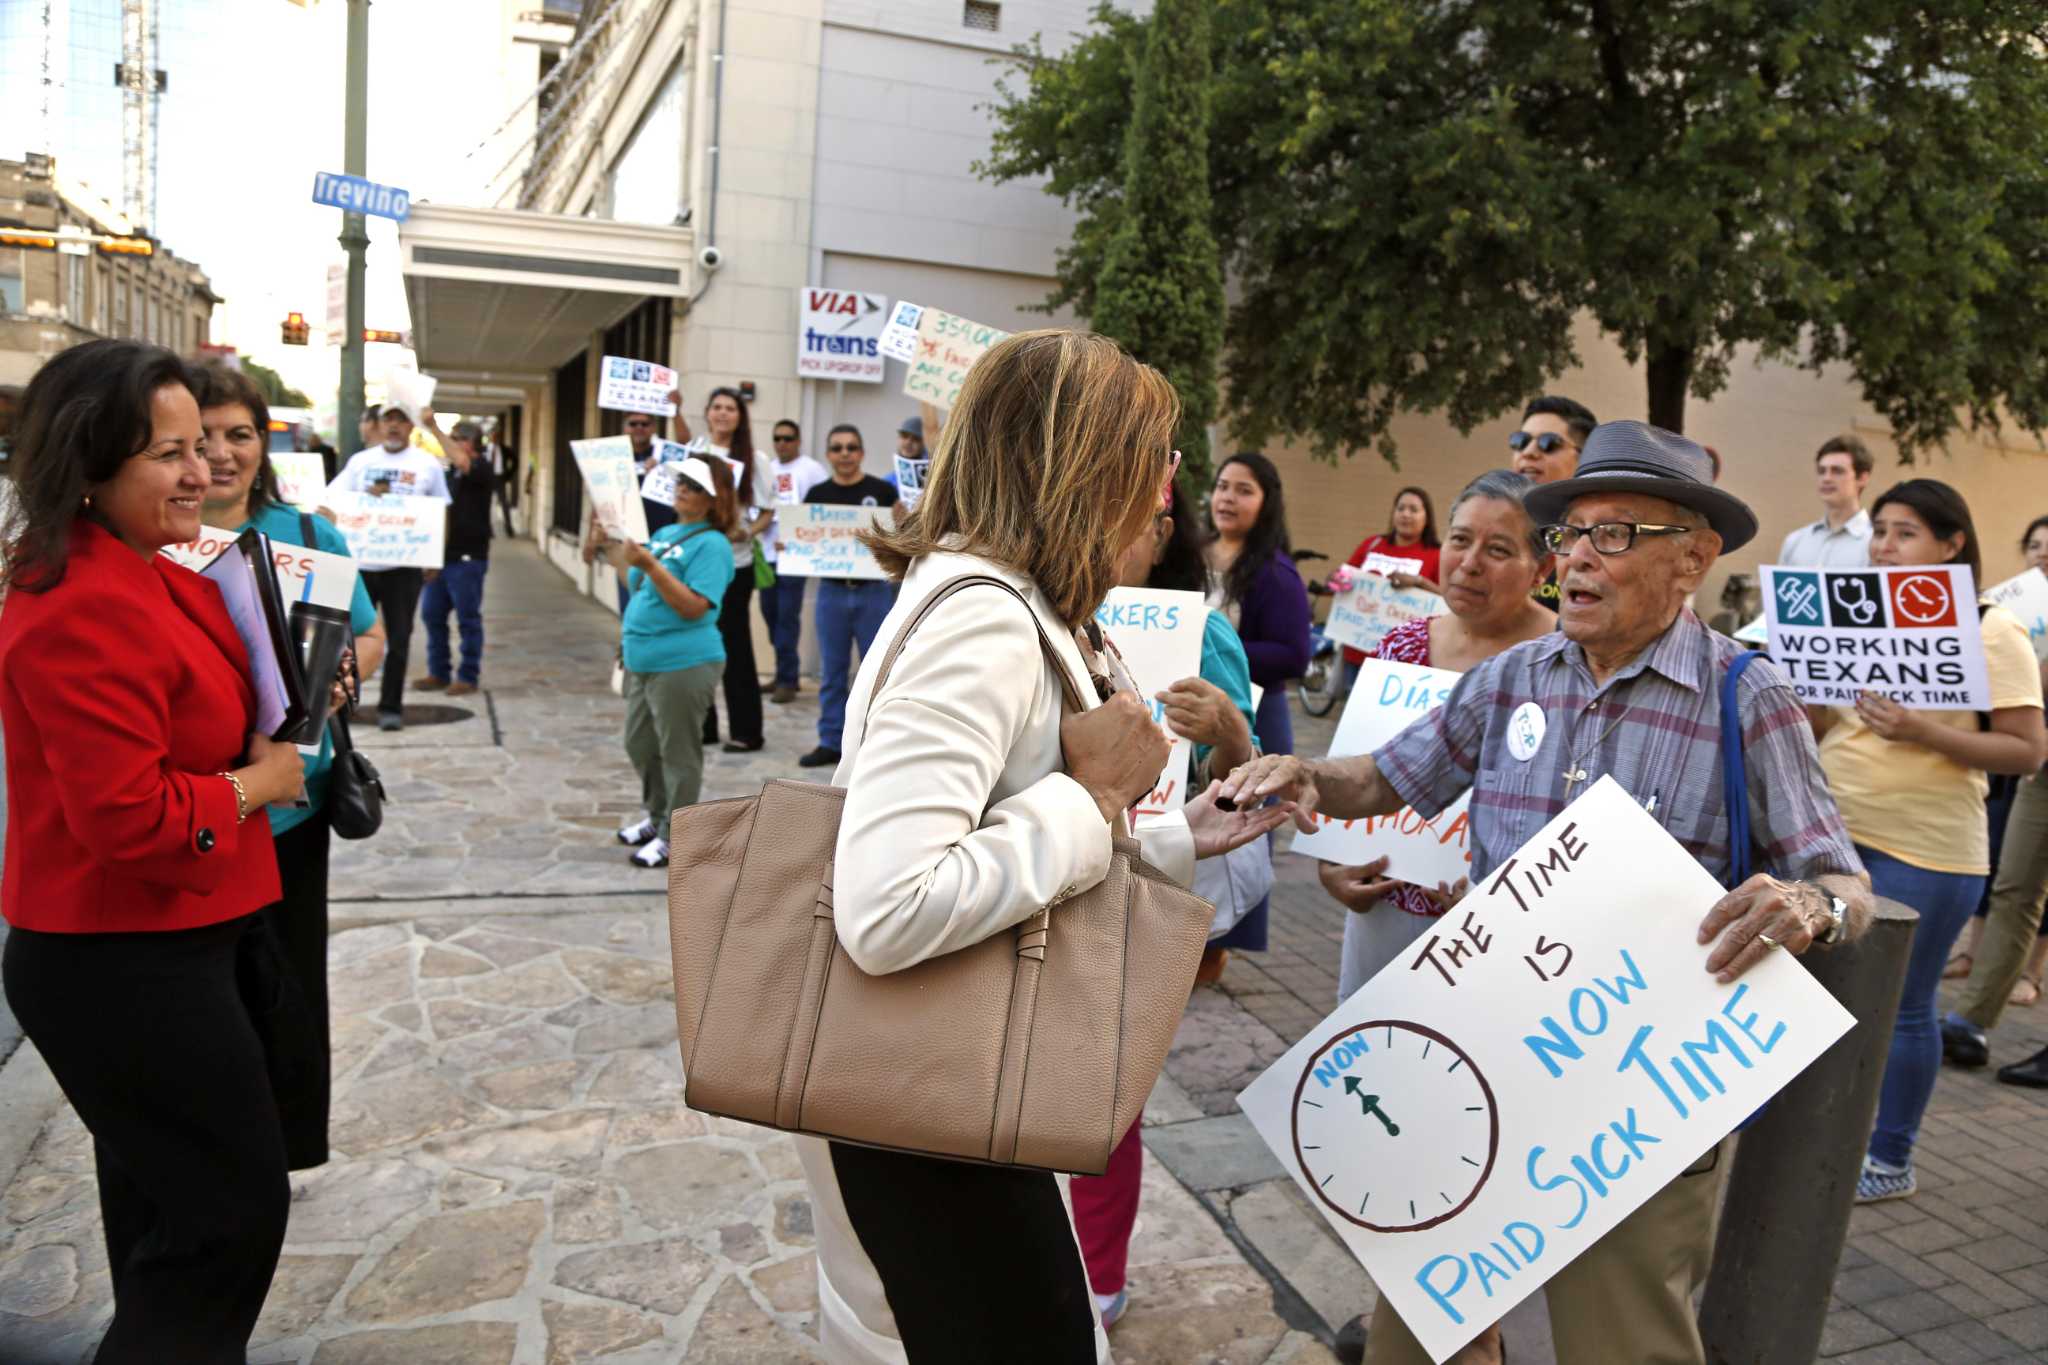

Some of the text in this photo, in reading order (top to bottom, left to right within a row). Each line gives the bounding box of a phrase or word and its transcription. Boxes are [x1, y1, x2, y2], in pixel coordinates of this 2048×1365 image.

[810, 290, 858, 315] VIA
[806, 327, 879, 357] trans
[1095, 603, 1180, 631] RKERS
[1779, 634, 1962, 657] WORKING
[1781, 657, 1966, 686] TEXANS
[1793, 685, 1819, 698] OR
[1873, 690, 1915, 703] ICK
[1921, 690, 1971, 704] TIME
[1410, 820, 1590, 987] THE TIME
[1523, 935, 1574, 982] IS
[1523, 949, 1650, 1079] NOW
[1312, 1032, 1371, 1089] NOW
[1414, 983, 1788, 1325] PAID SICK TIME
